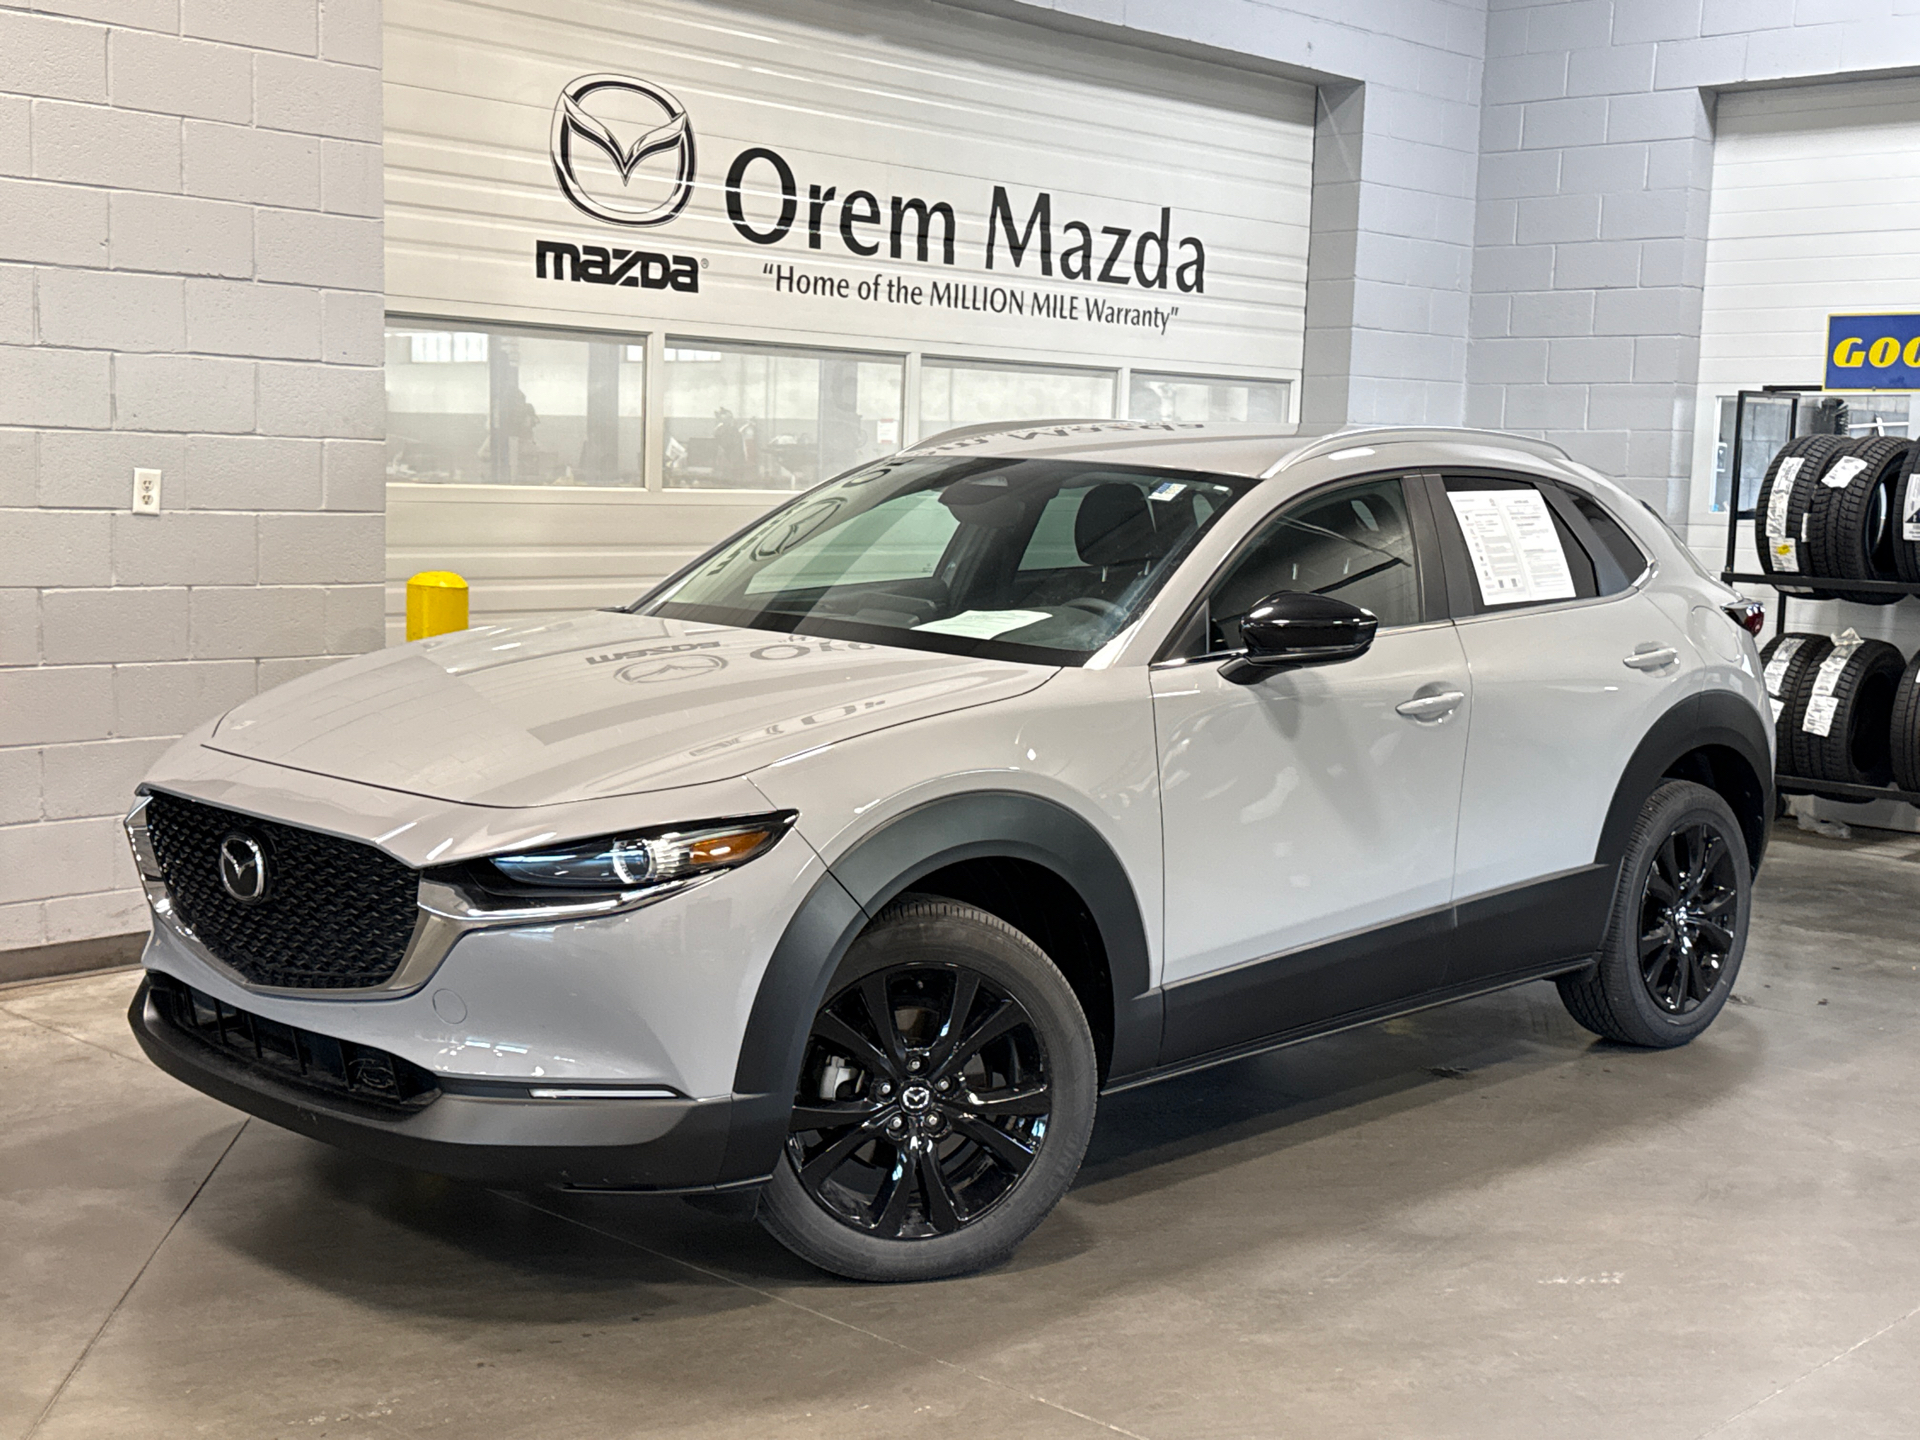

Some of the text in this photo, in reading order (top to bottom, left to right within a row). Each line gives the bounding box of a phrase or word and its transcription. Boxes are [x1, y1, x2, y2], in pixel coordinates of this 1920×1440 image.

[724, 147, 1206, 295] Orem Mazda
[535, 239, 699, 293] mazda
[762, 262, 1180, 336] "Home of the MILLION MILE Warranty"
